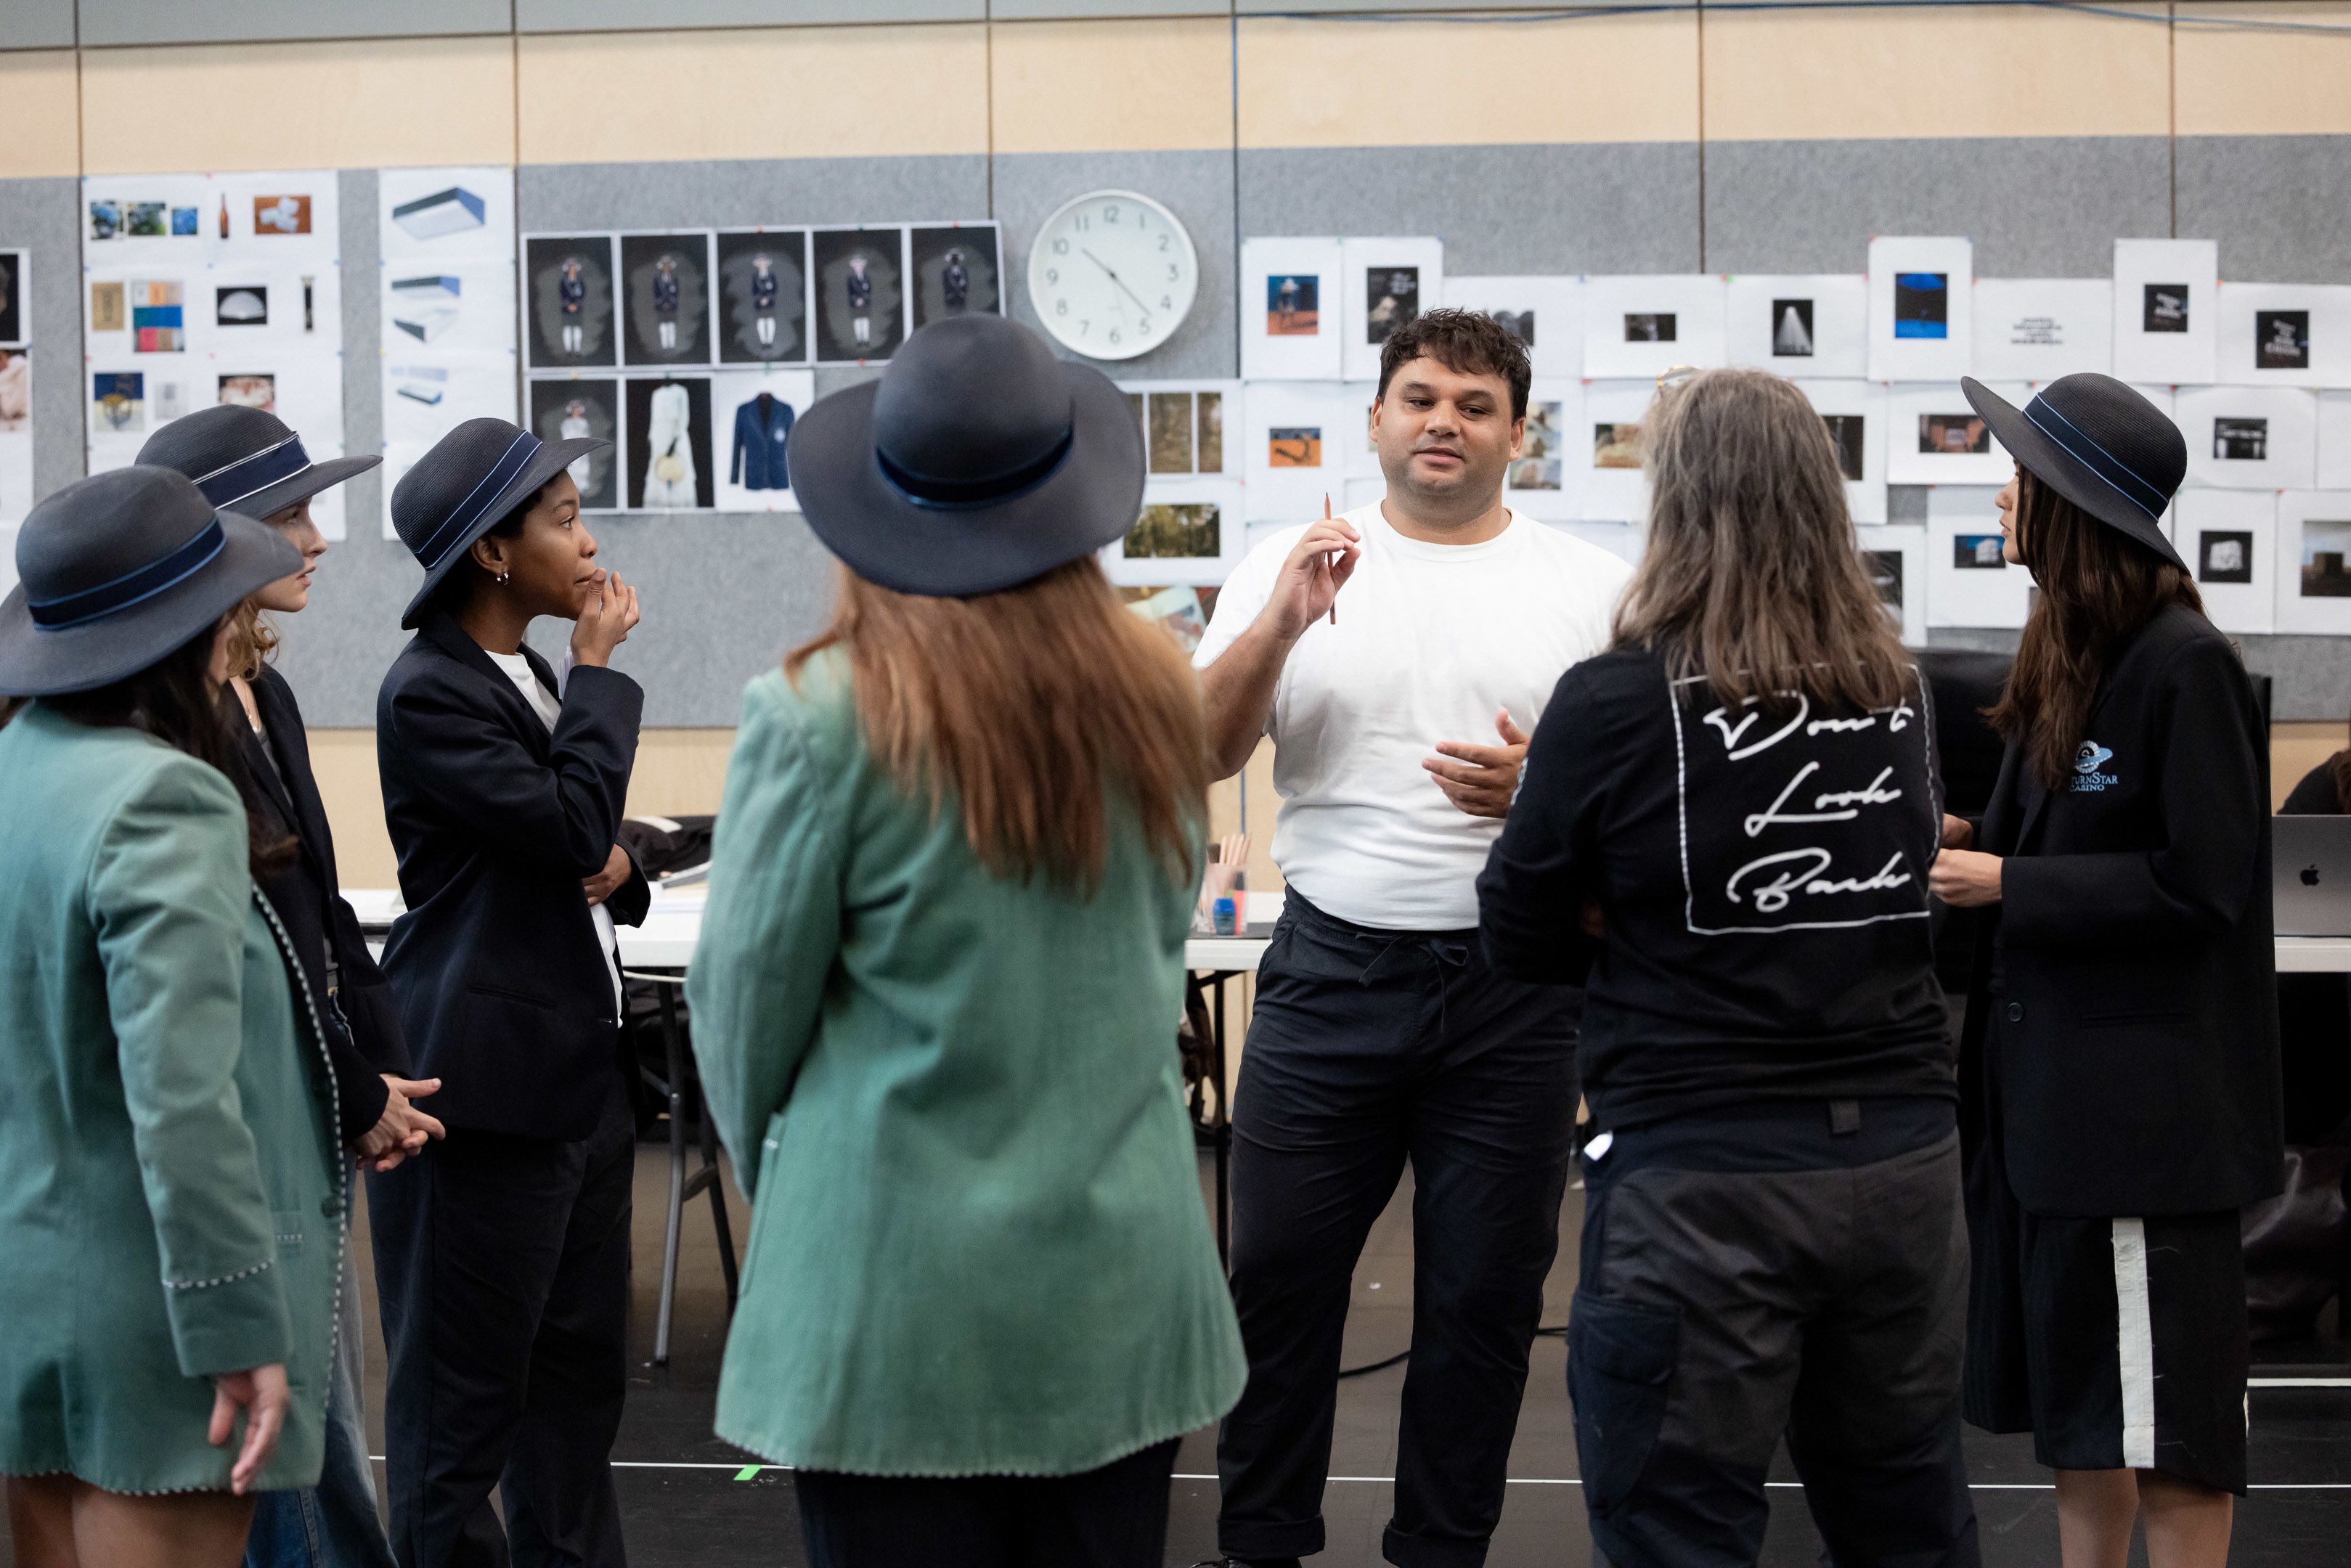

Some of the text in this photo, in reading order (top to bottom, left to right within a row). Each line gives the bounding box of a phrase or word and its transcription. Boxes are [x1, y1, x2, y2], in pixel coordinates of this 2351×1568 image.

[1103, 205, 1119, 224] 12
[1075, 216, 1090, 232] 11
[1052, 238, 1069, 256] 10
[1158, 234, 1169, 251] 2
[1046, 269, 1058, 285] 9
[1168, 264, 1178, 281] 3
[1056, 299, 1067, 316] 8
[1161, 295, 1171, 310] 4
[1080, 319, 1090, 335] 7
[1139, 318, 1150, 334] 5
[1109, 327, 1120, 343] 6
[1703, 690, 1915, 761] Dont
[1744, 760, 1902, 838] Look
[1726, 846, 1912, 913] Back
